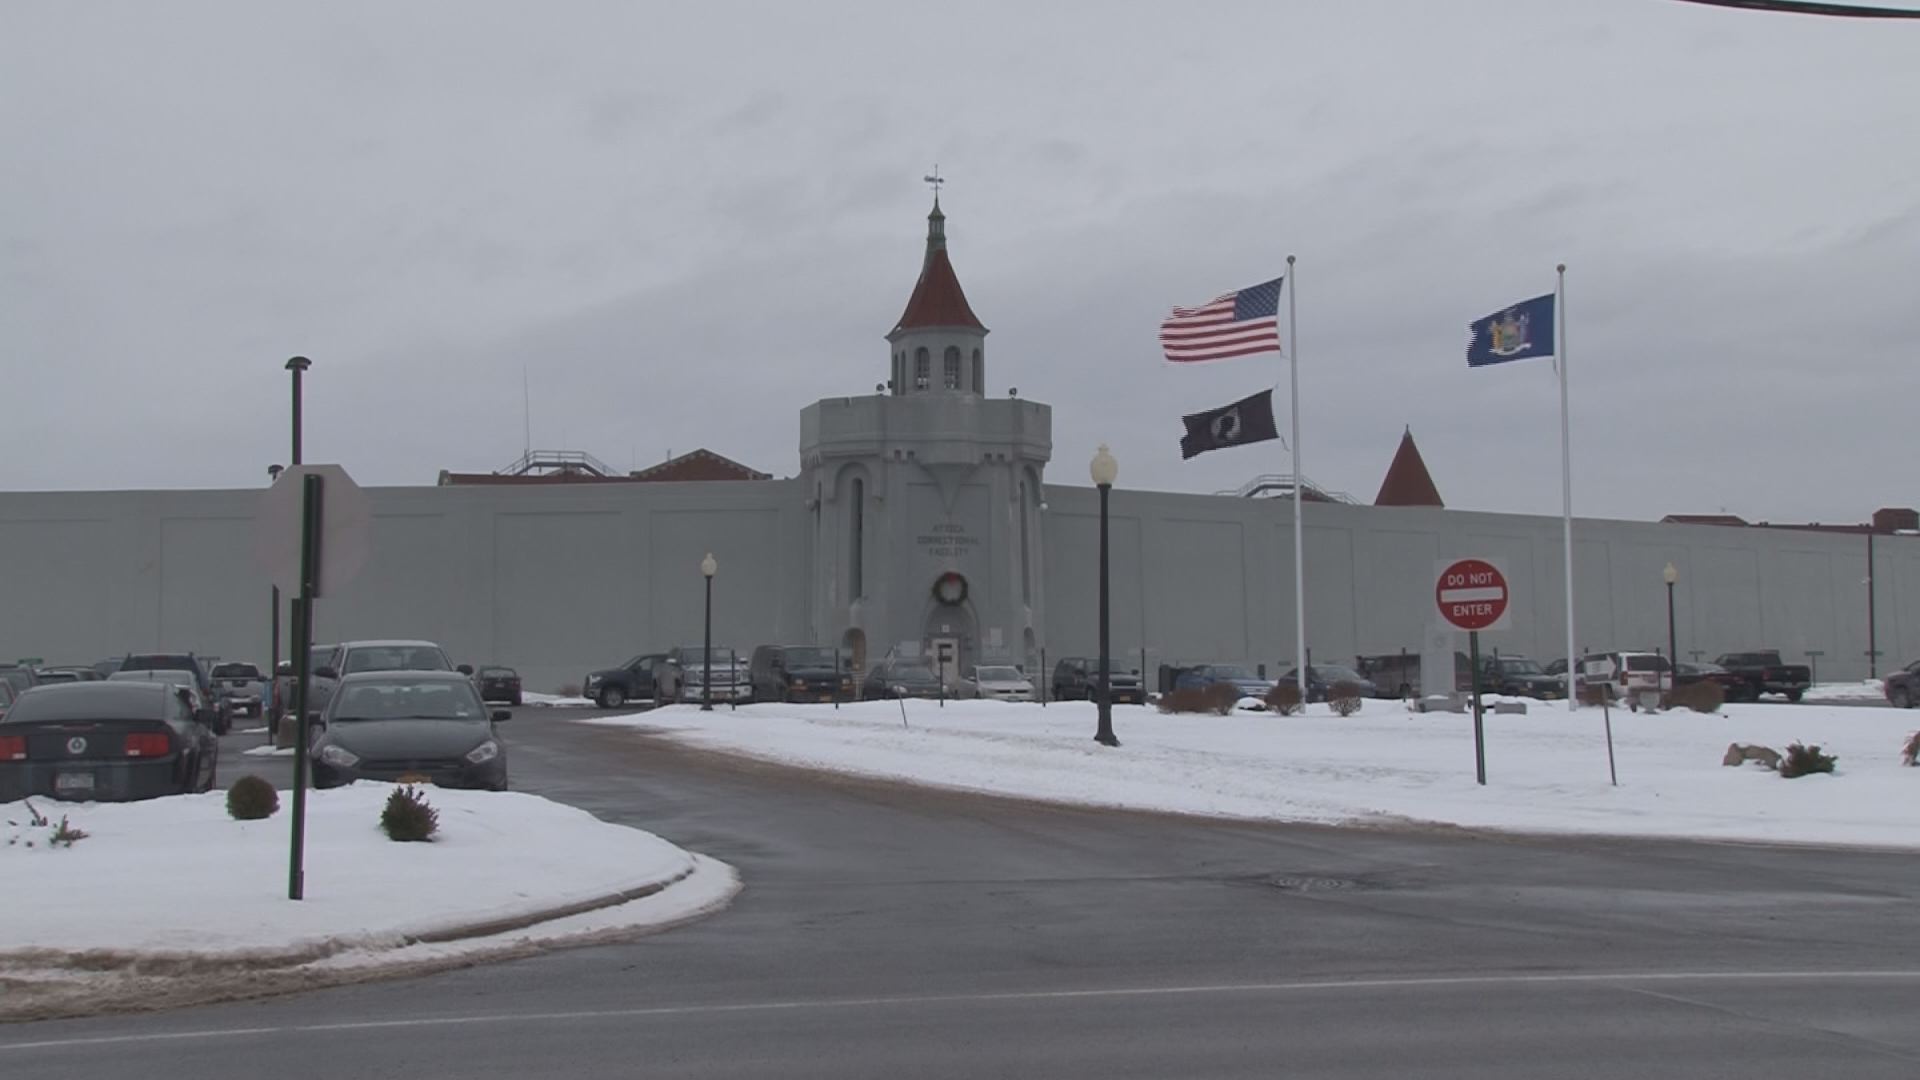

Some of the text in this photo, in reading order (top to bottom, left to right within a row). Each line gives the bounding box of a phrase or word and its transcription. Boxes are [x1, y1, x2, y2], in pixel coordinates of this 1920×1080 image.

[932, 524, 965, 534] ATTICA
[917, 535, 981, 545] CORRECTIONAL
[929, 547, 969, 557] FACILITY
[1447, 572, 1493, 586] DO NOT
[1453, 604, 1493, 617] ENTER
